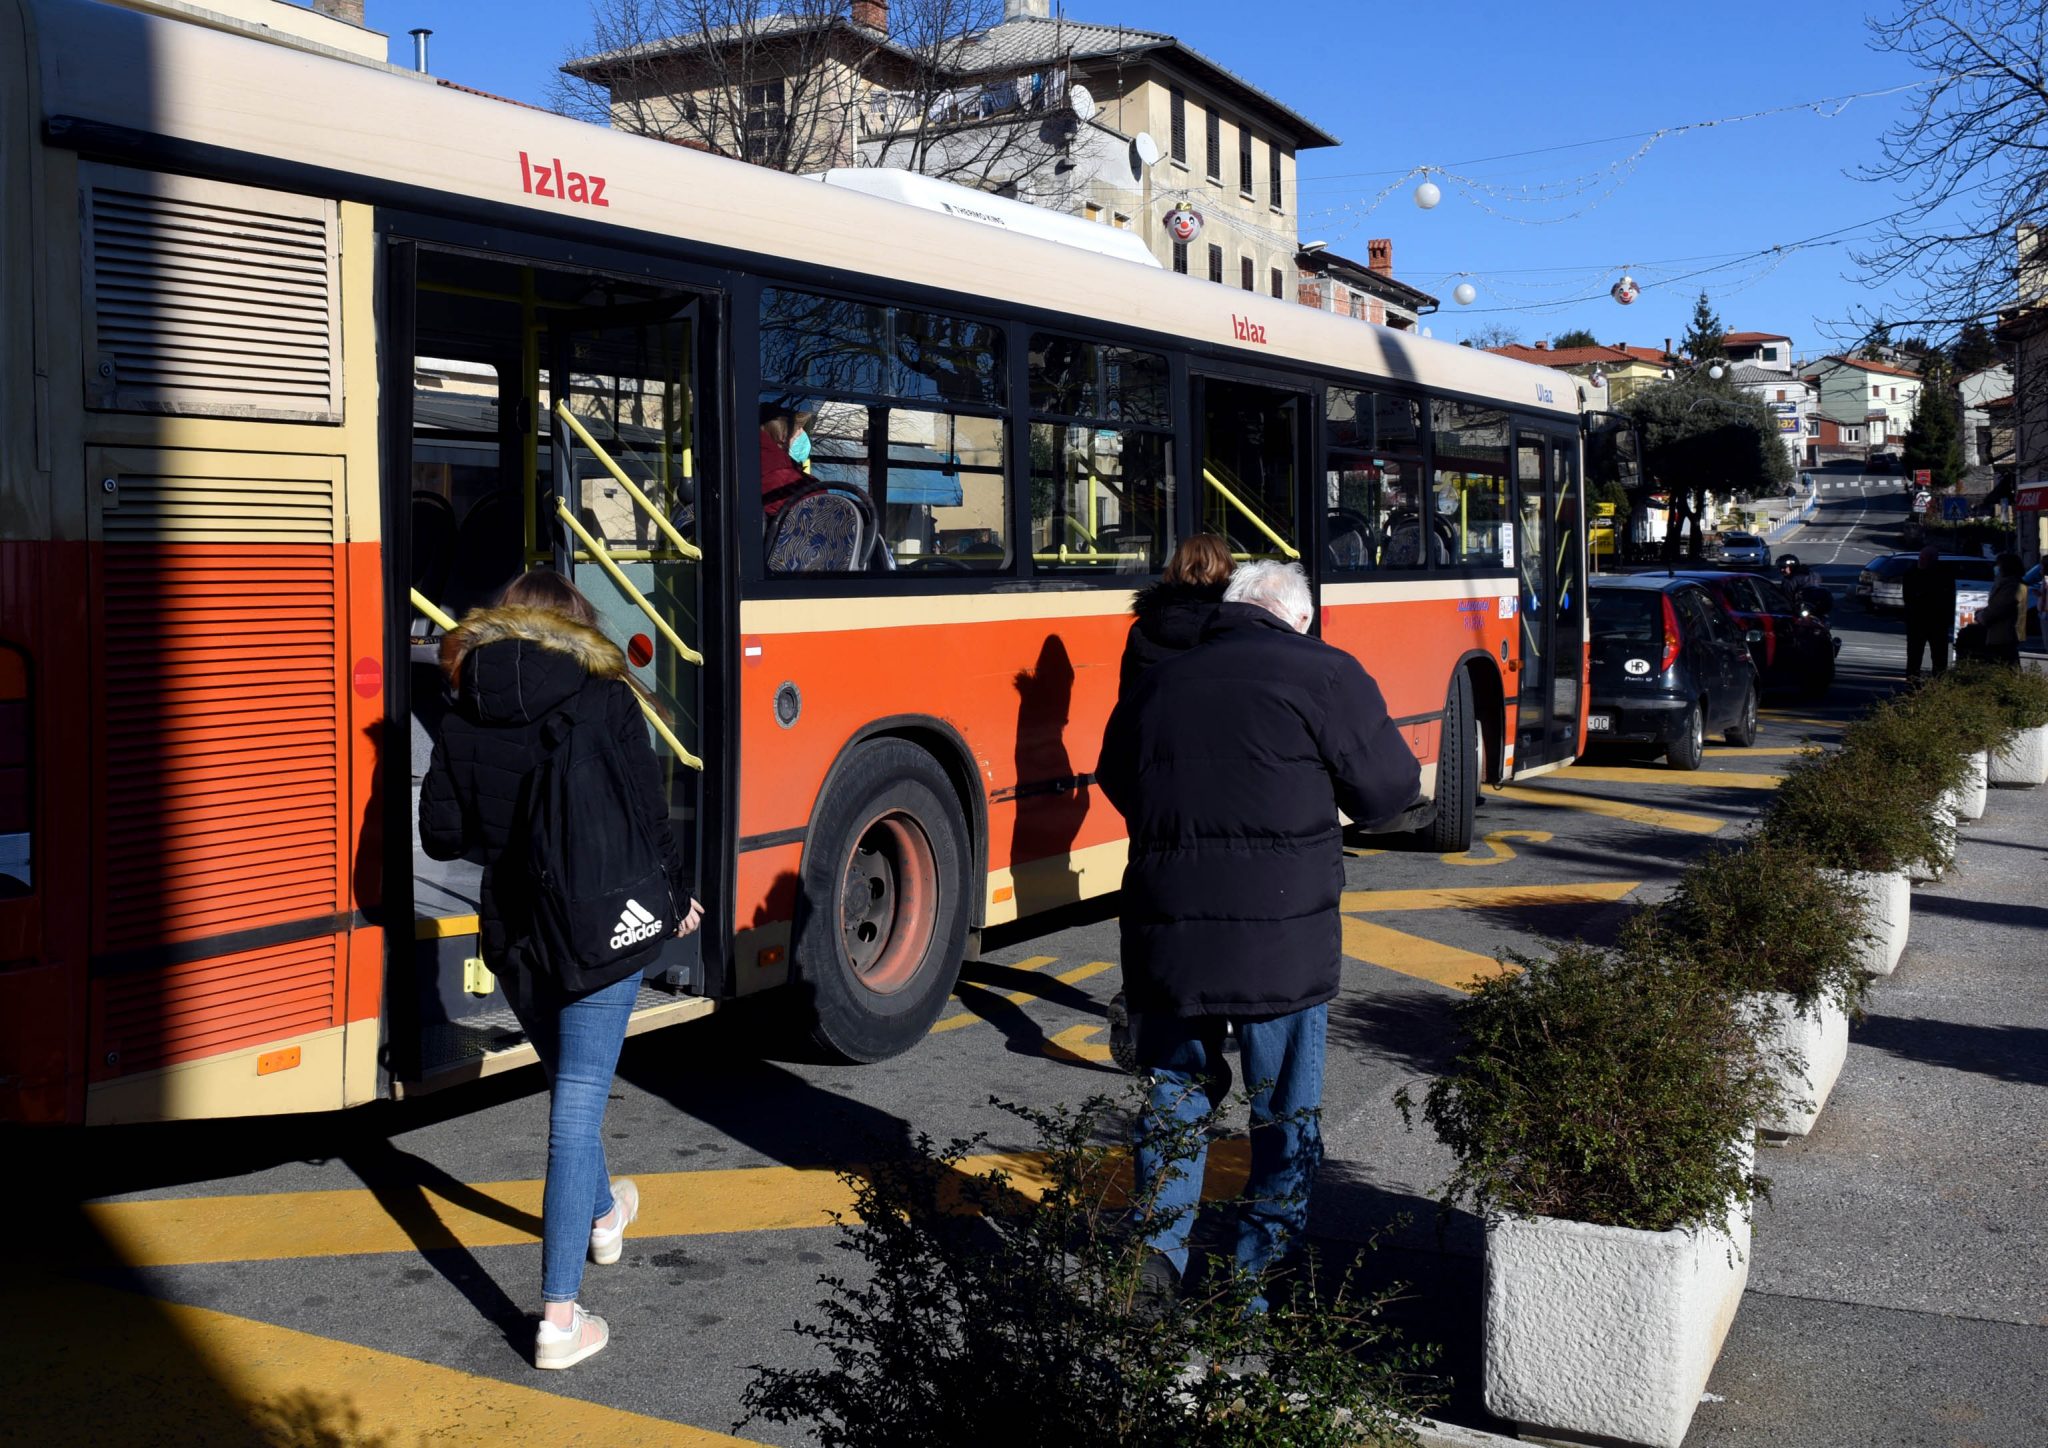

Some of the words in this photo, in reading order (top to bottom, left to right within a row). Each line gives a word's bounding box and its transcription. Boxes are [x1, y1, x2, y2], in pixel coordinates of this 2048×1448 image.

[519, 151, 609, 207] Izlaz
[1232, 314, 1267, 345] Izlaz
[1536, 384, 1554, 404] Ulaz
[1631, 661, 1645, 673] HR
[610, 919, 663, 950] adidas
